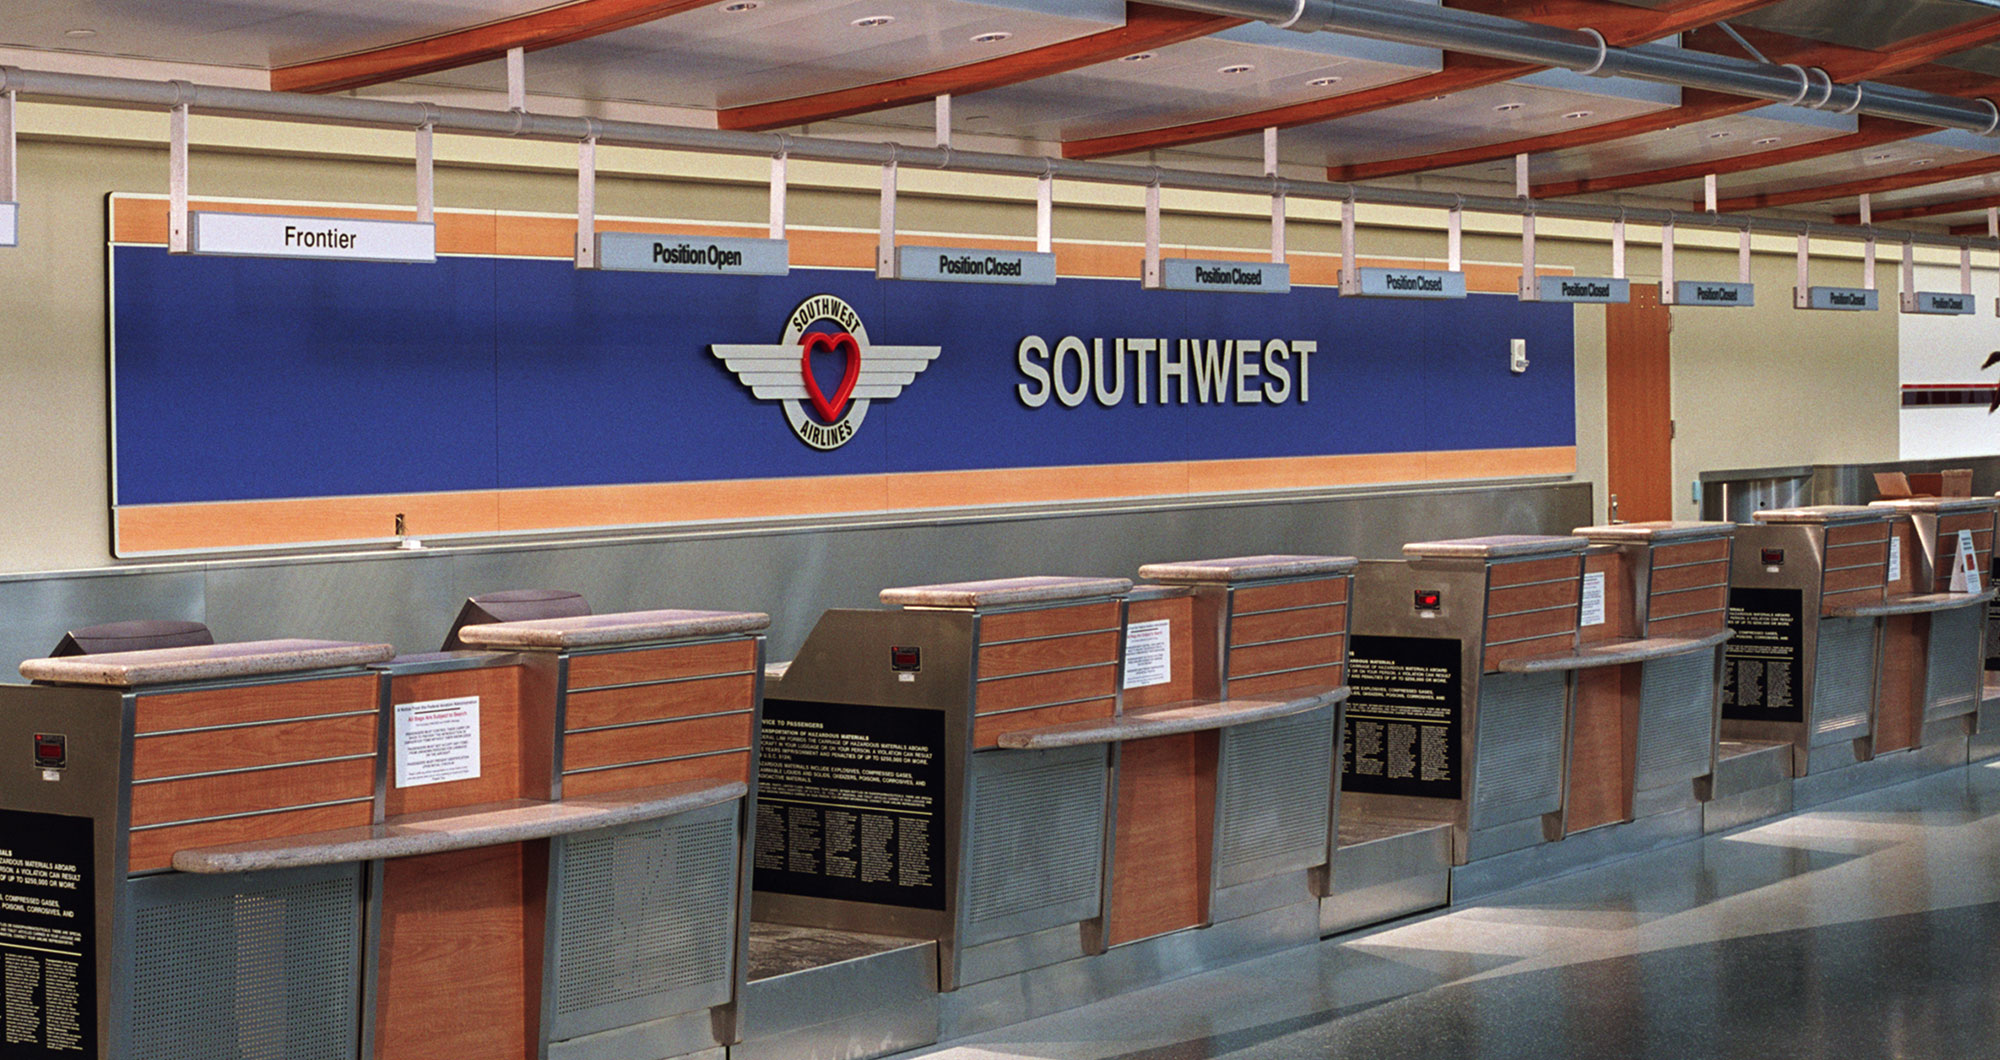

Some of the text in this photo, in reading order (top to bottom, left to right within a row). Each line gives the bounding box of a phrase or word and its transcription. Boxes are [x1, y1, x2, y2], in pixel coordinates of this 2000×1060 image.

[285, 226, 357, 249] Frontier
[653, 242, 742, 270] Position Open
[939, 255, 1022, 277] Position Closed
[1195, 266, 1261, 285] Position Closed
[1386, 274, 1442, 291] Position Closed
[1562, 282, 1610, 297] Position Closed
[793, 298, 860, 334] SOUTHWEST
[1017, 335, 1318, 407] SOUTHWEST
[800, 420, 853, 447] AIRLINES
[786, 721, 824, 729] PASSENGERS
[21, 868, 48, 877] VIOLATION
[49, 871, 60, 879] CAN
[61, 873, 81, 881] RESULT
[24, 860, 53, 870] MATERIALS
[54, 863, 77, 872] ABOARD
[62, 910, 75, 918] AND
